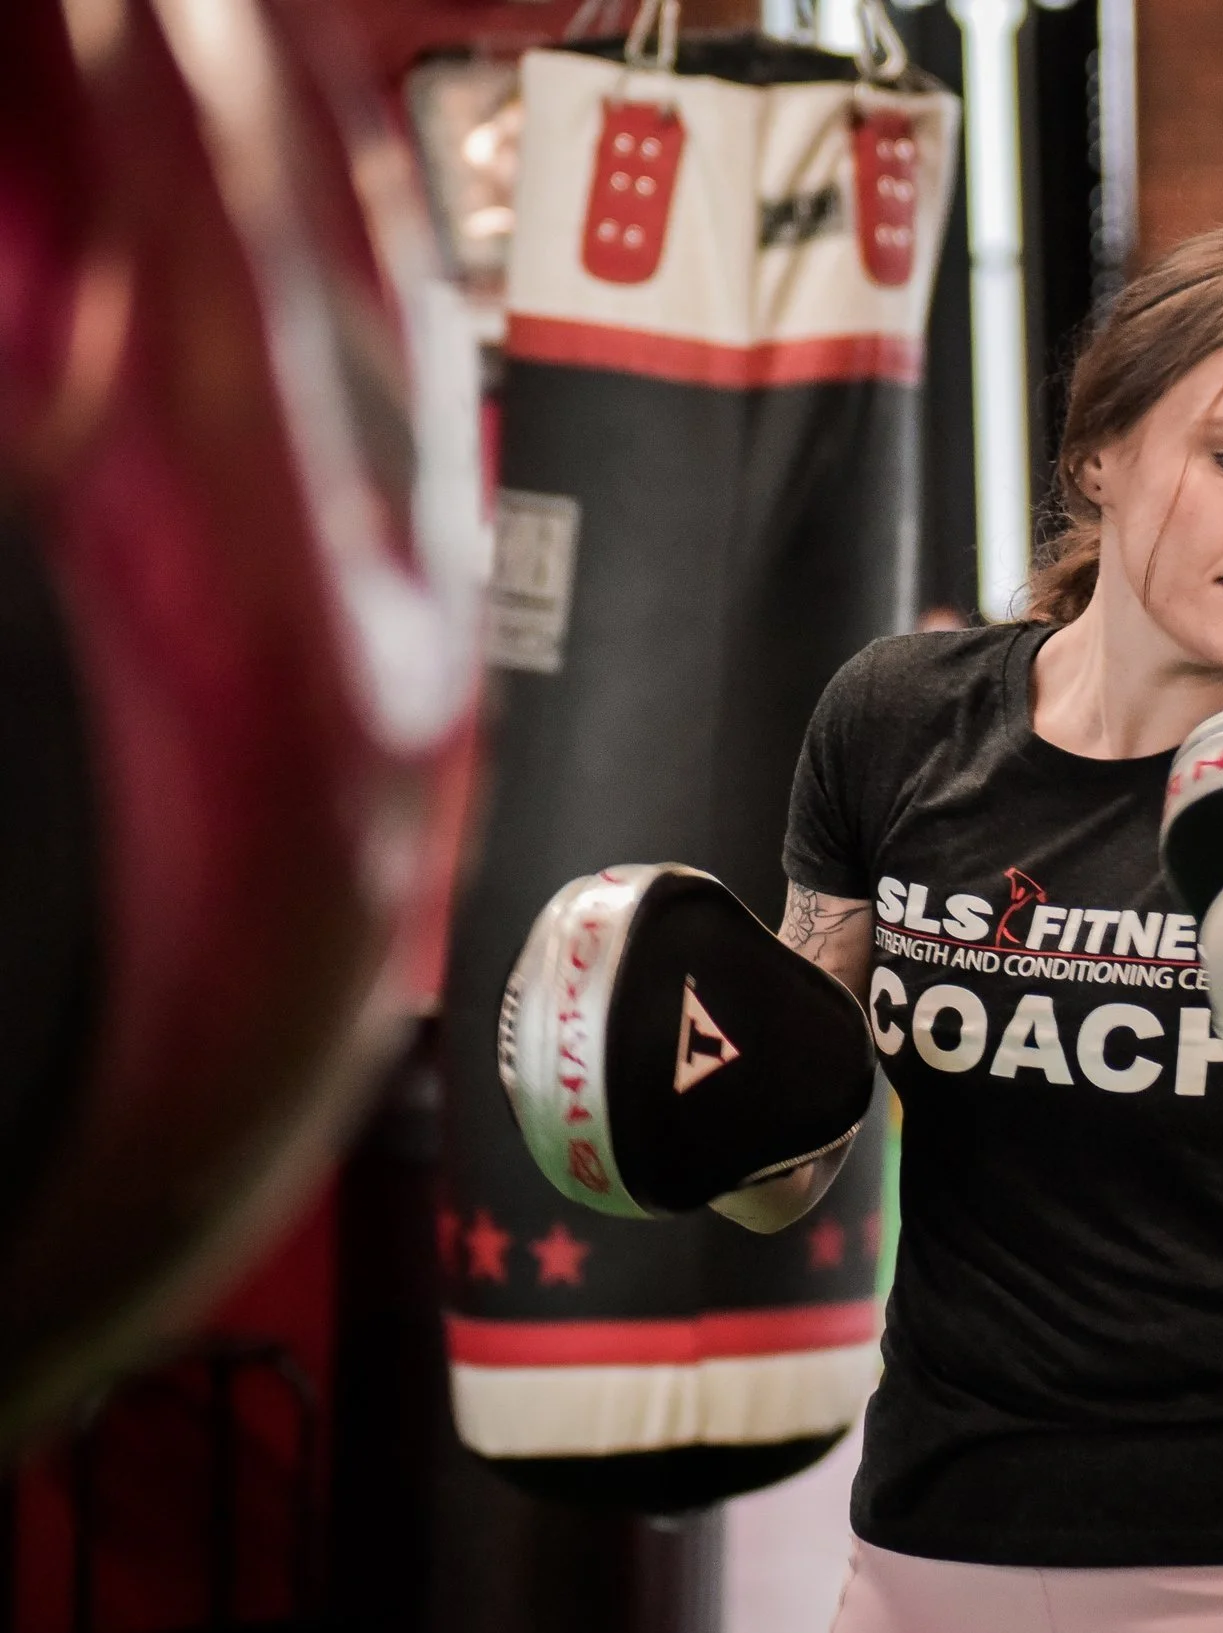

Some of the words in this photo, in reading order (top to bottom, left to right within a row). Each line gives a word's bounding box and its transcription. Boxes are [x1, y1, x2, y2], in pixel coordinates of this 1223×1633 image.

[876, 876, 994, 942] SLS
[1025, 904, 1207, 961] FITNE
[875, 926, 950, 966] STRENGTH
[951, 947, 1000, 973] AND
[1003, 955, 1174, 989] CONDITIONING
